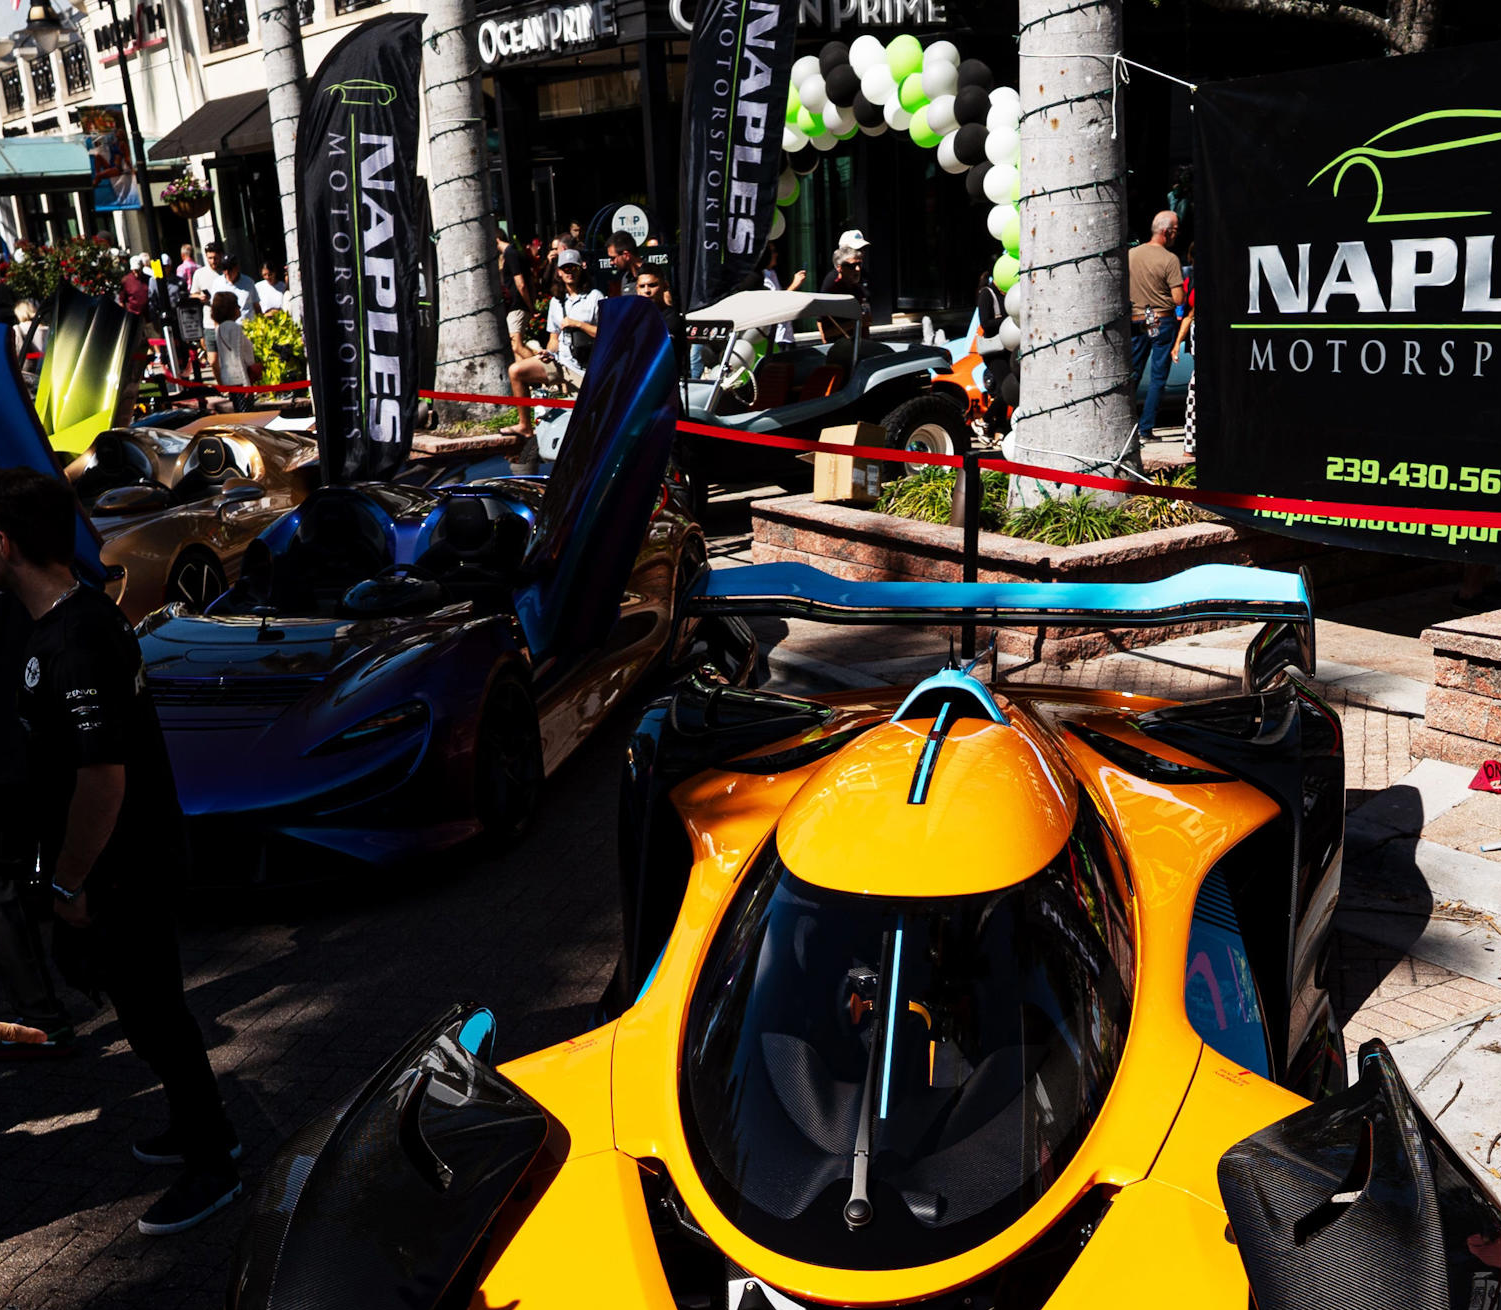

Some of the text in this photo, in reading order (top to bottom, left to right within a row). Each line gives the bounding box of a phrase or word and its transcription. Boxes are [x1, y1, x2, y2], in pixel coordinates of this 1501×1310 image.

[478, 13, 547, 64] OCEAN
[547, 0, 616, 51] PRIME
[703, 0, 739, 252] MOTORSPORTS
[727, 1, 780, 255] NAPLES
[327, 131, 362, 440] MOTORSPORTS
[359, 132, 403, 443] NAPLES
[65, 688, 98, 699] ZENVO
